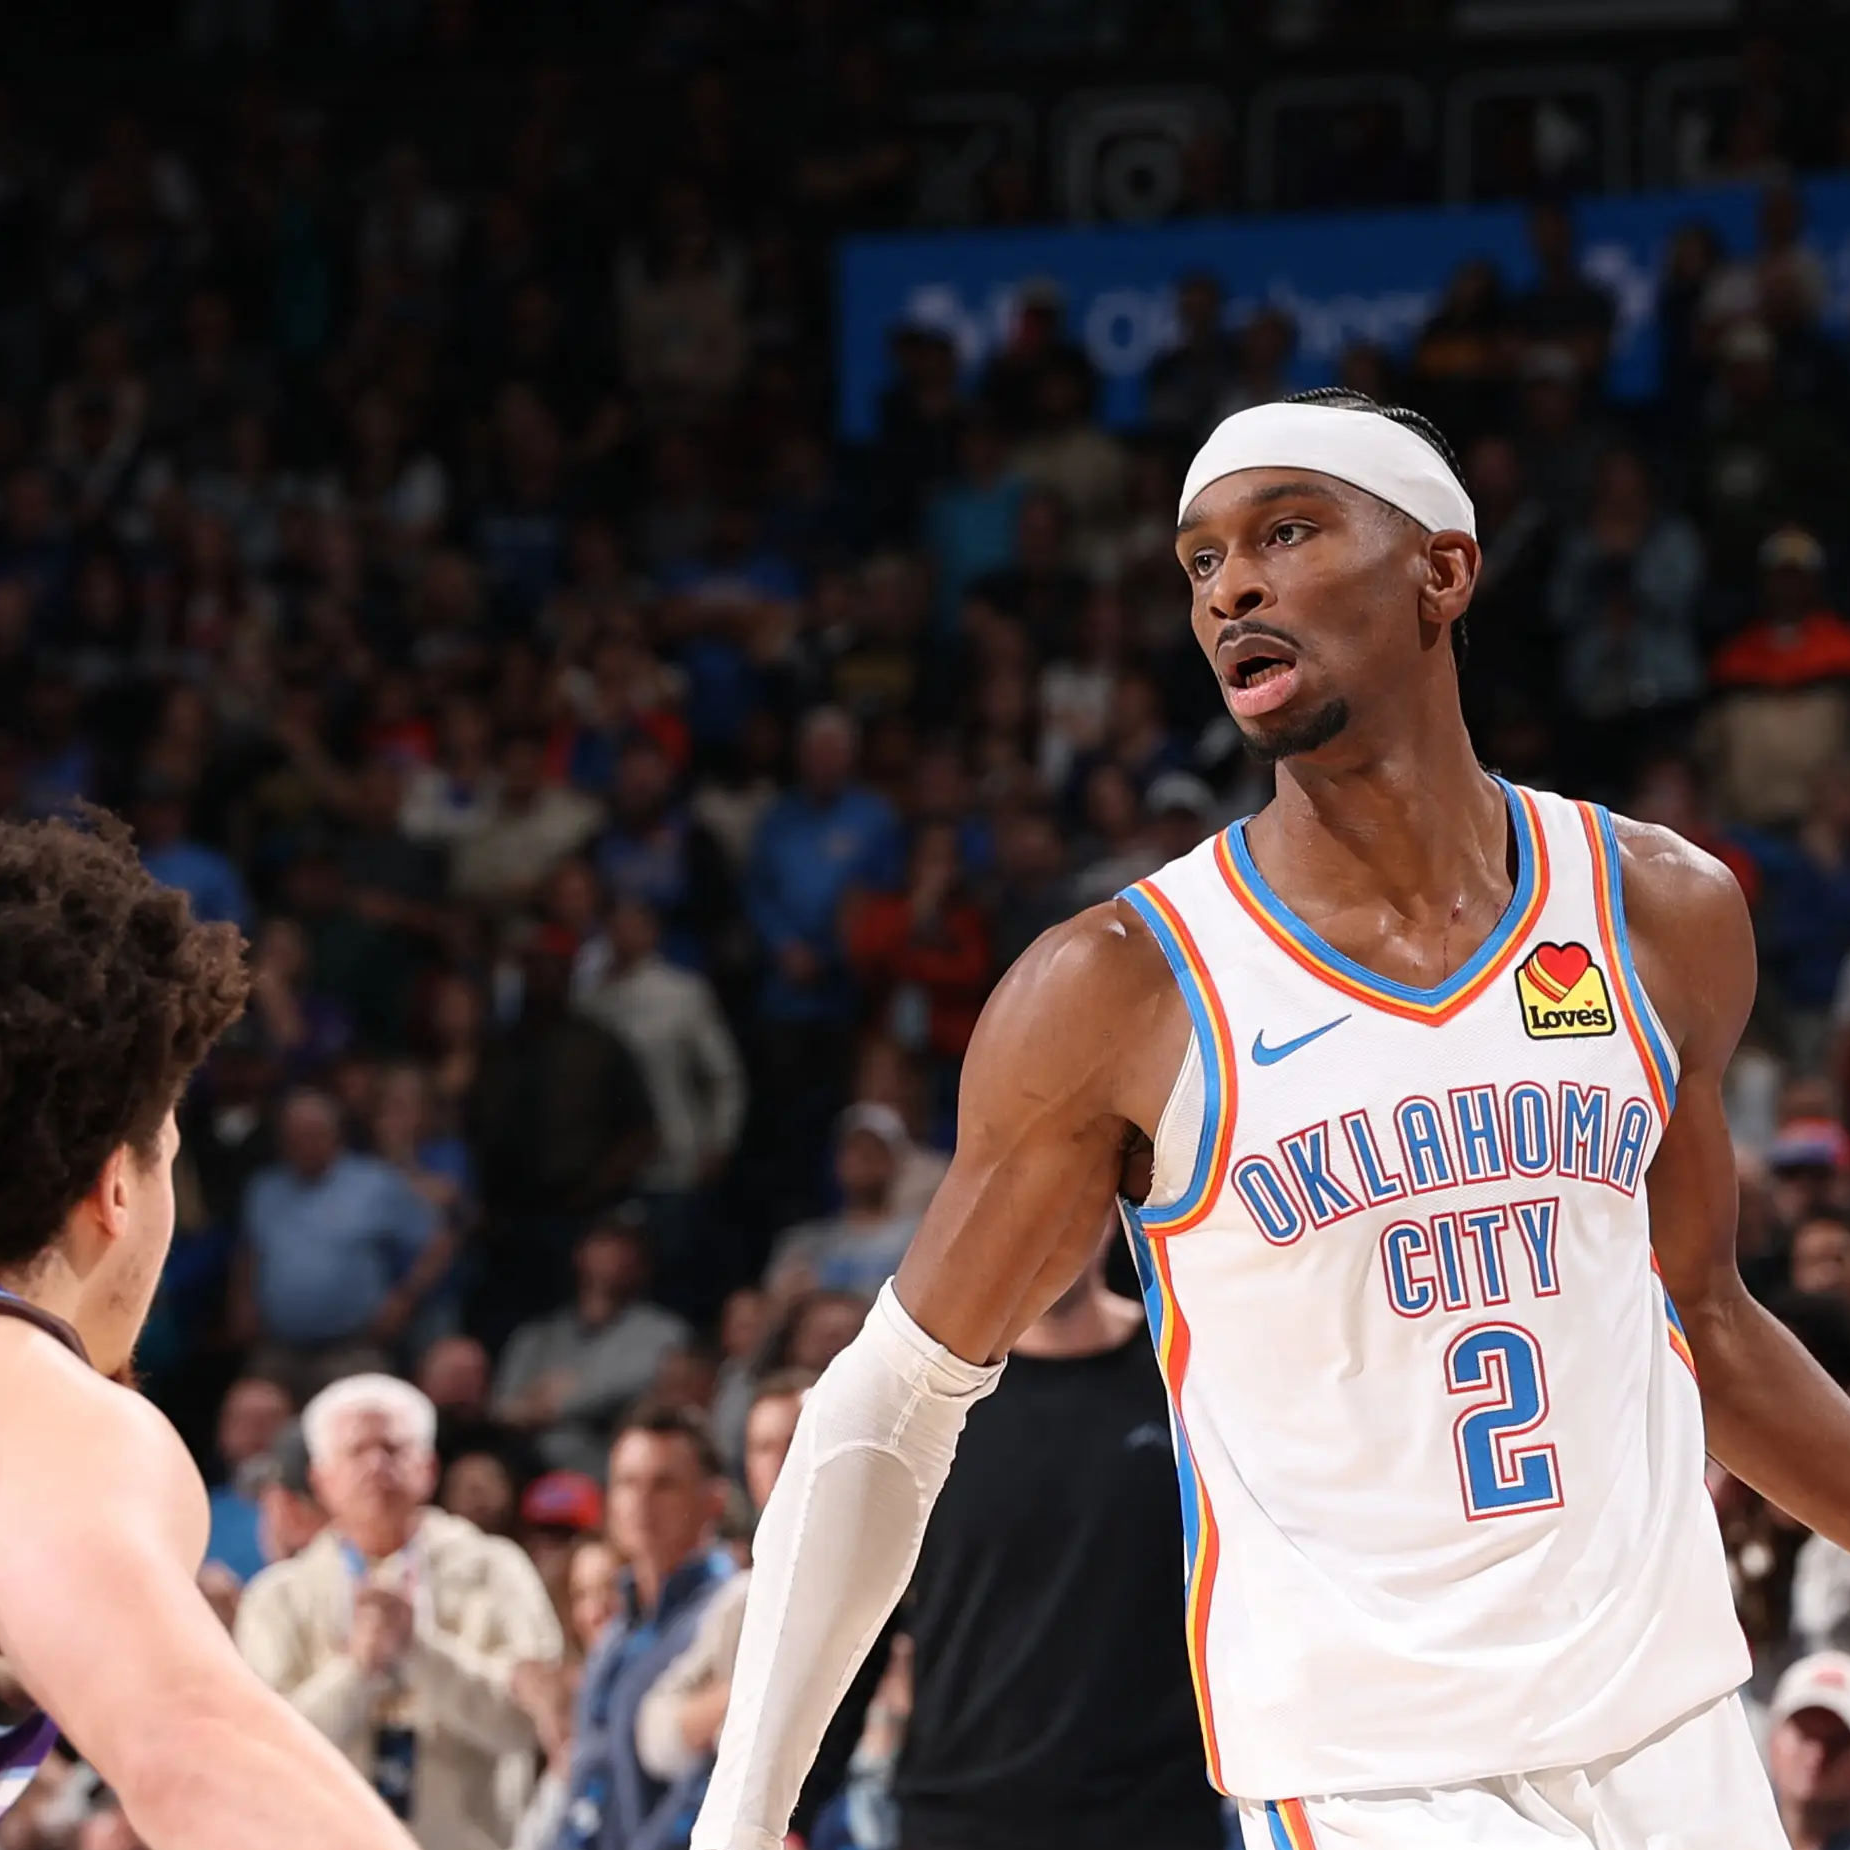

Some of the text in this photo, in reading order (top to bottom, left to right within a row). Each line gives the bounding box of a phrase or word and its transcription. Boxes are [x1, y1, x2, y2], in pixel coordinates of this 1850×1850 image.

[1231, 1080, 1654, 1247] OKLAHOMA
[1380, 1197, 1560, 1318] CITY
[1444, 1321, 1564, 1521] 2
